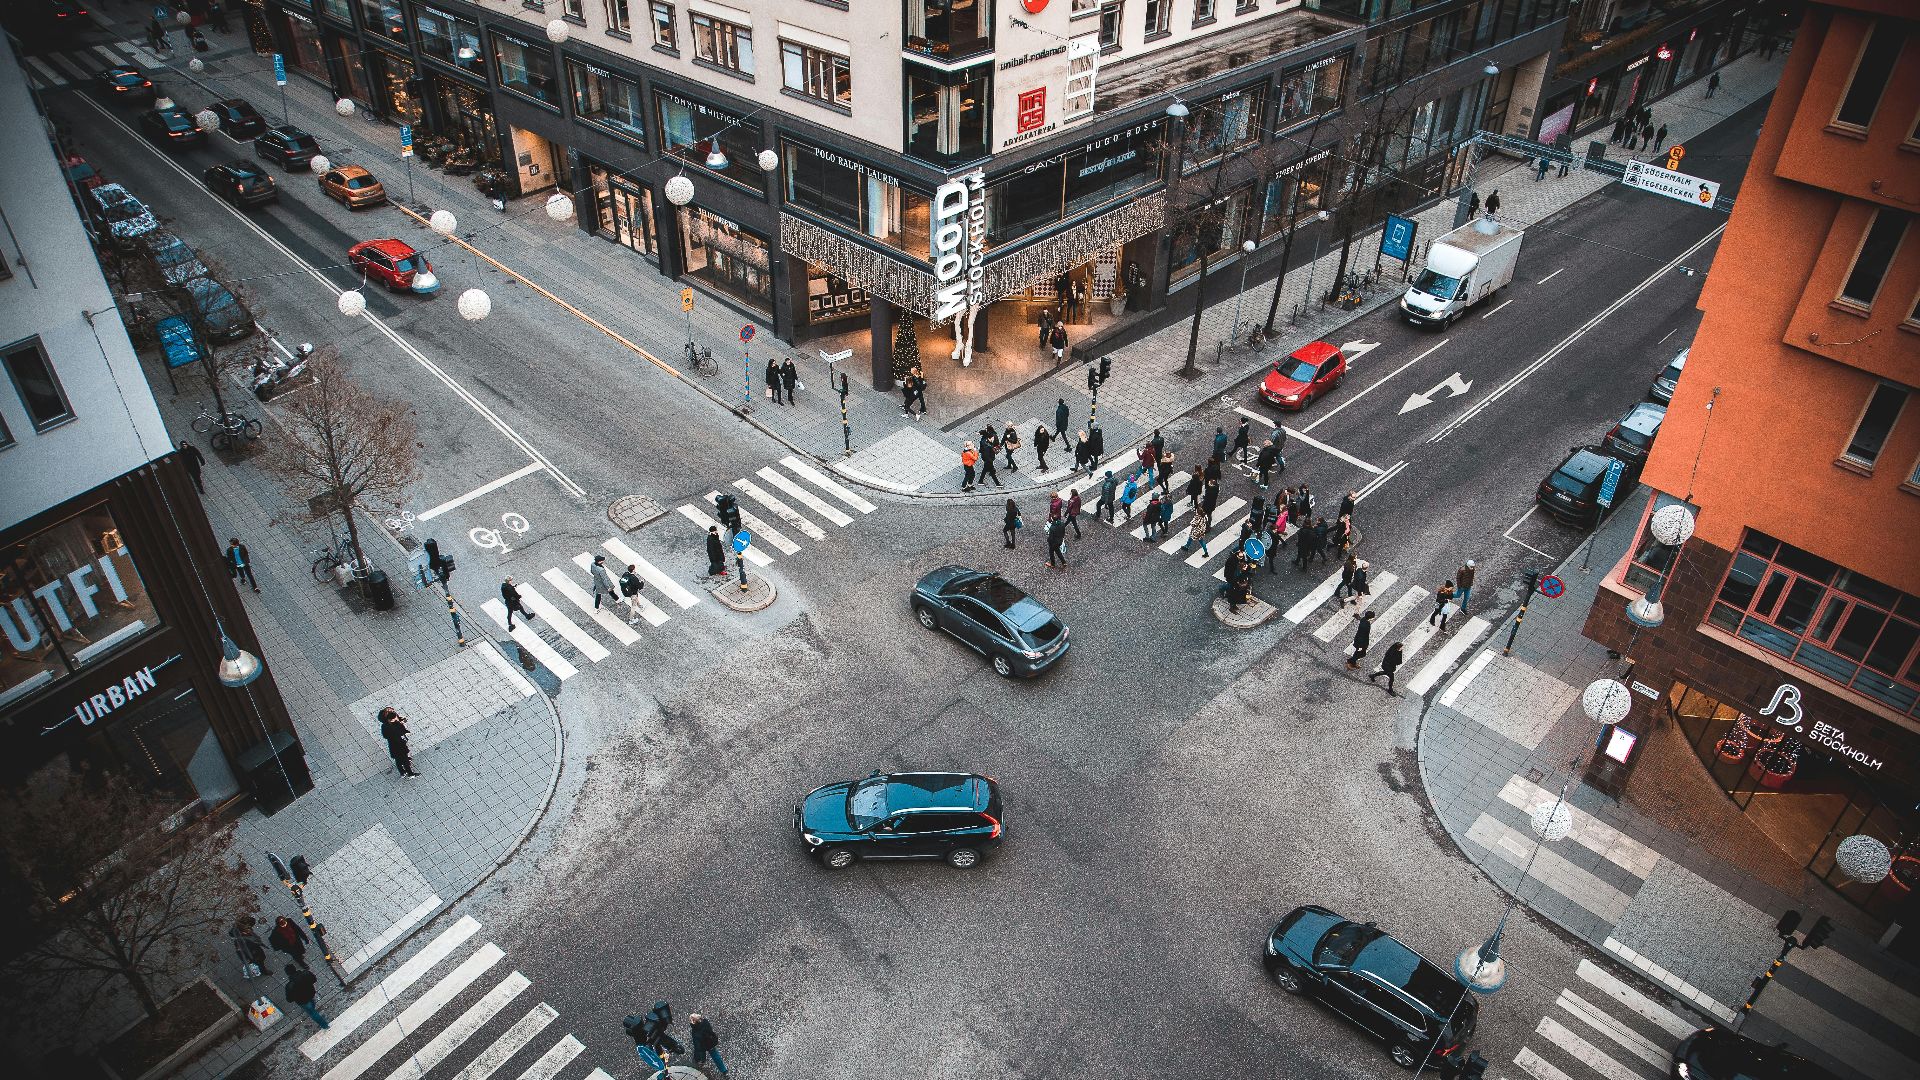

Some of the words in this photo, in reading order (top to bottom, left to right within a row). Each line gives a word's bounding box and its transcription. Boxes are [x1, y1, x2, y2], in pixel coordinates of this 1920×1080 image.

[669, 94, 697, 111] TOMMY
[707, 108, 742, 128] HILFIGER
[1086, 134, 1119, 153] HUGO
[1126, 119, 1158, 138] BOSS
[814, 147, 836, 163] POLO
[837, 155, 864, 174] RALPH
[865, 166, 900, 188] LAUREN
[1024, 152, 1068, 174] GANT
[1644, 167, 1692, 186] SÖDERMALM
[1641, 178, 1694, 199] TEGELBACKEN
[935, 181, 969, 323] MOOD
[967, 168, 986, 306] STOCKHOLM
[74, 665, 156, 726] URBAN
[1814, 720, 1845, 742] BETA
[1809, 730, 1883, 771] STOCKHOLM
